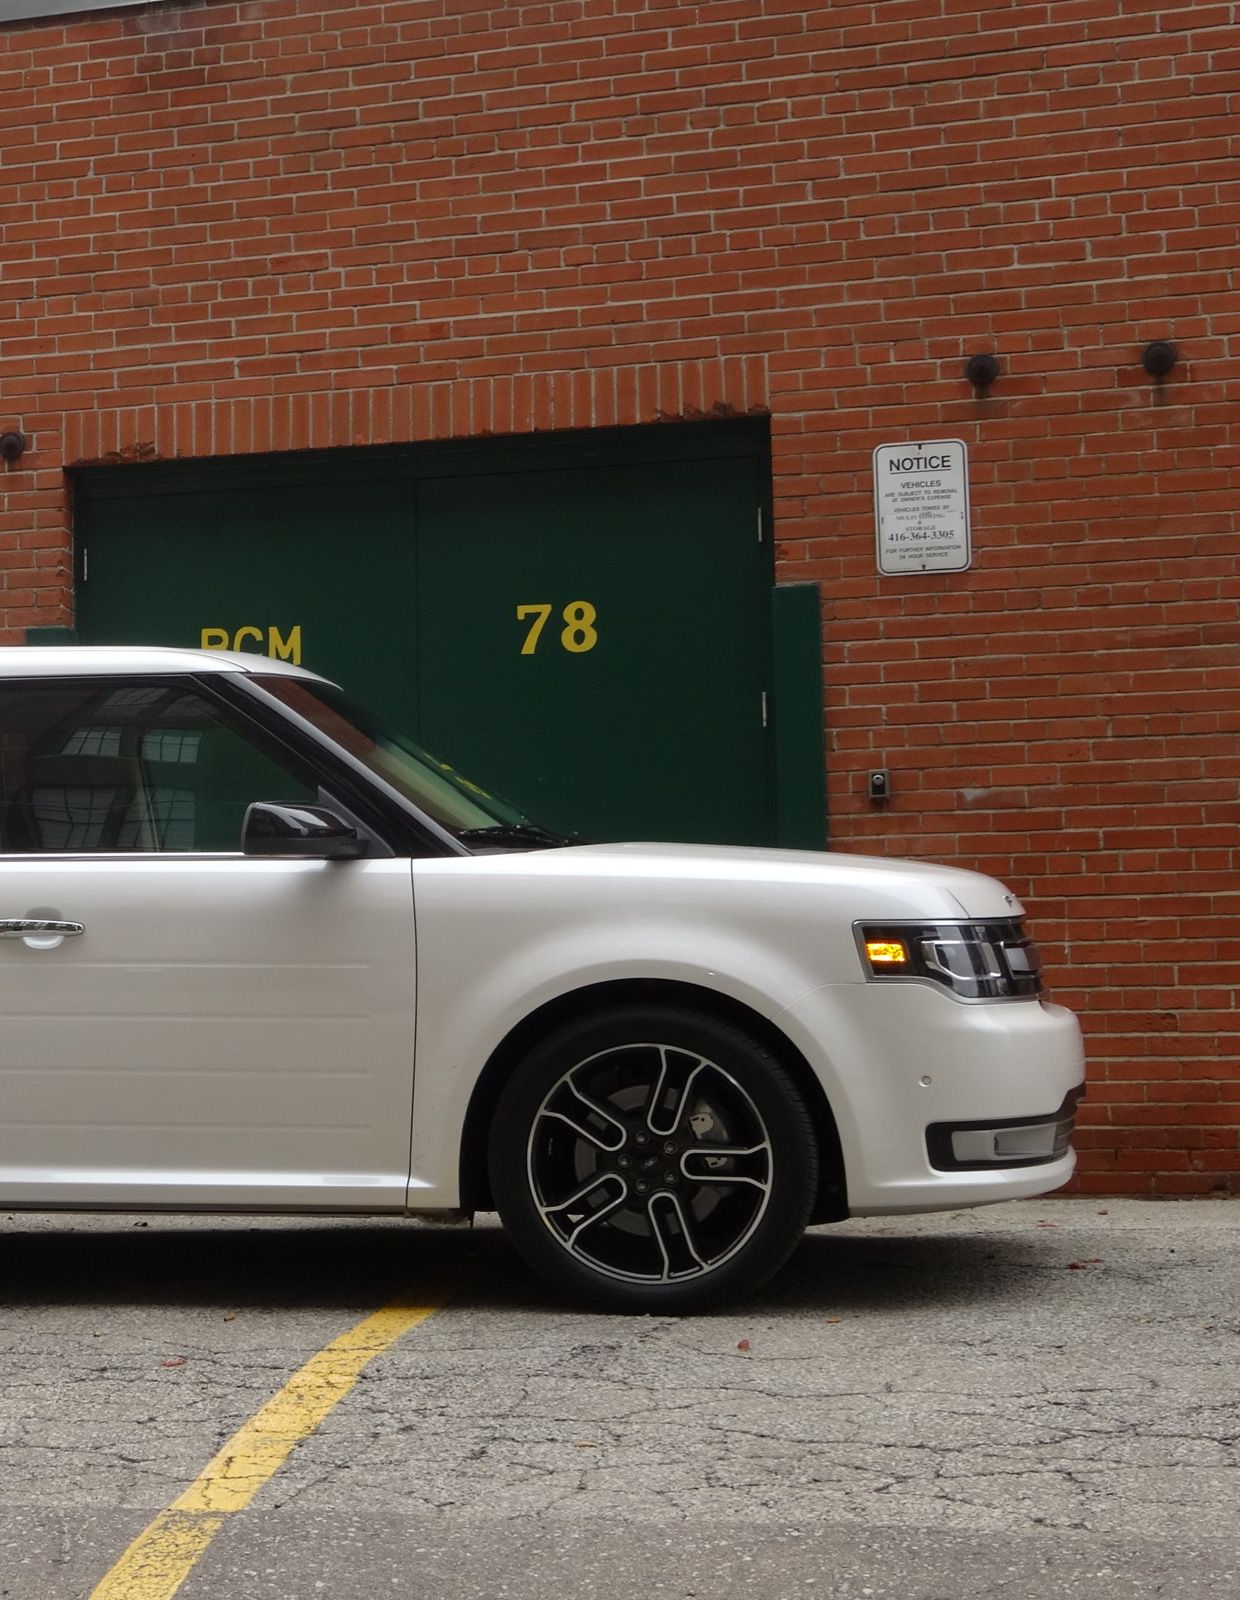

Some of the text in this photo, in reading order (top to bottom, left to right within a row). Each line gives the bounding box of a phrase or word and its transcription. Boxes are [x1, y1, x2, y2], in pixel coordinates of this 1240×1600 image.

[889, 455, 951, 471] NOTICE
[901, 480, 942, 489] VEHICLES
[888, 529, 955, 541] 416-364-3305
[517, 601, 598, 655] 78
